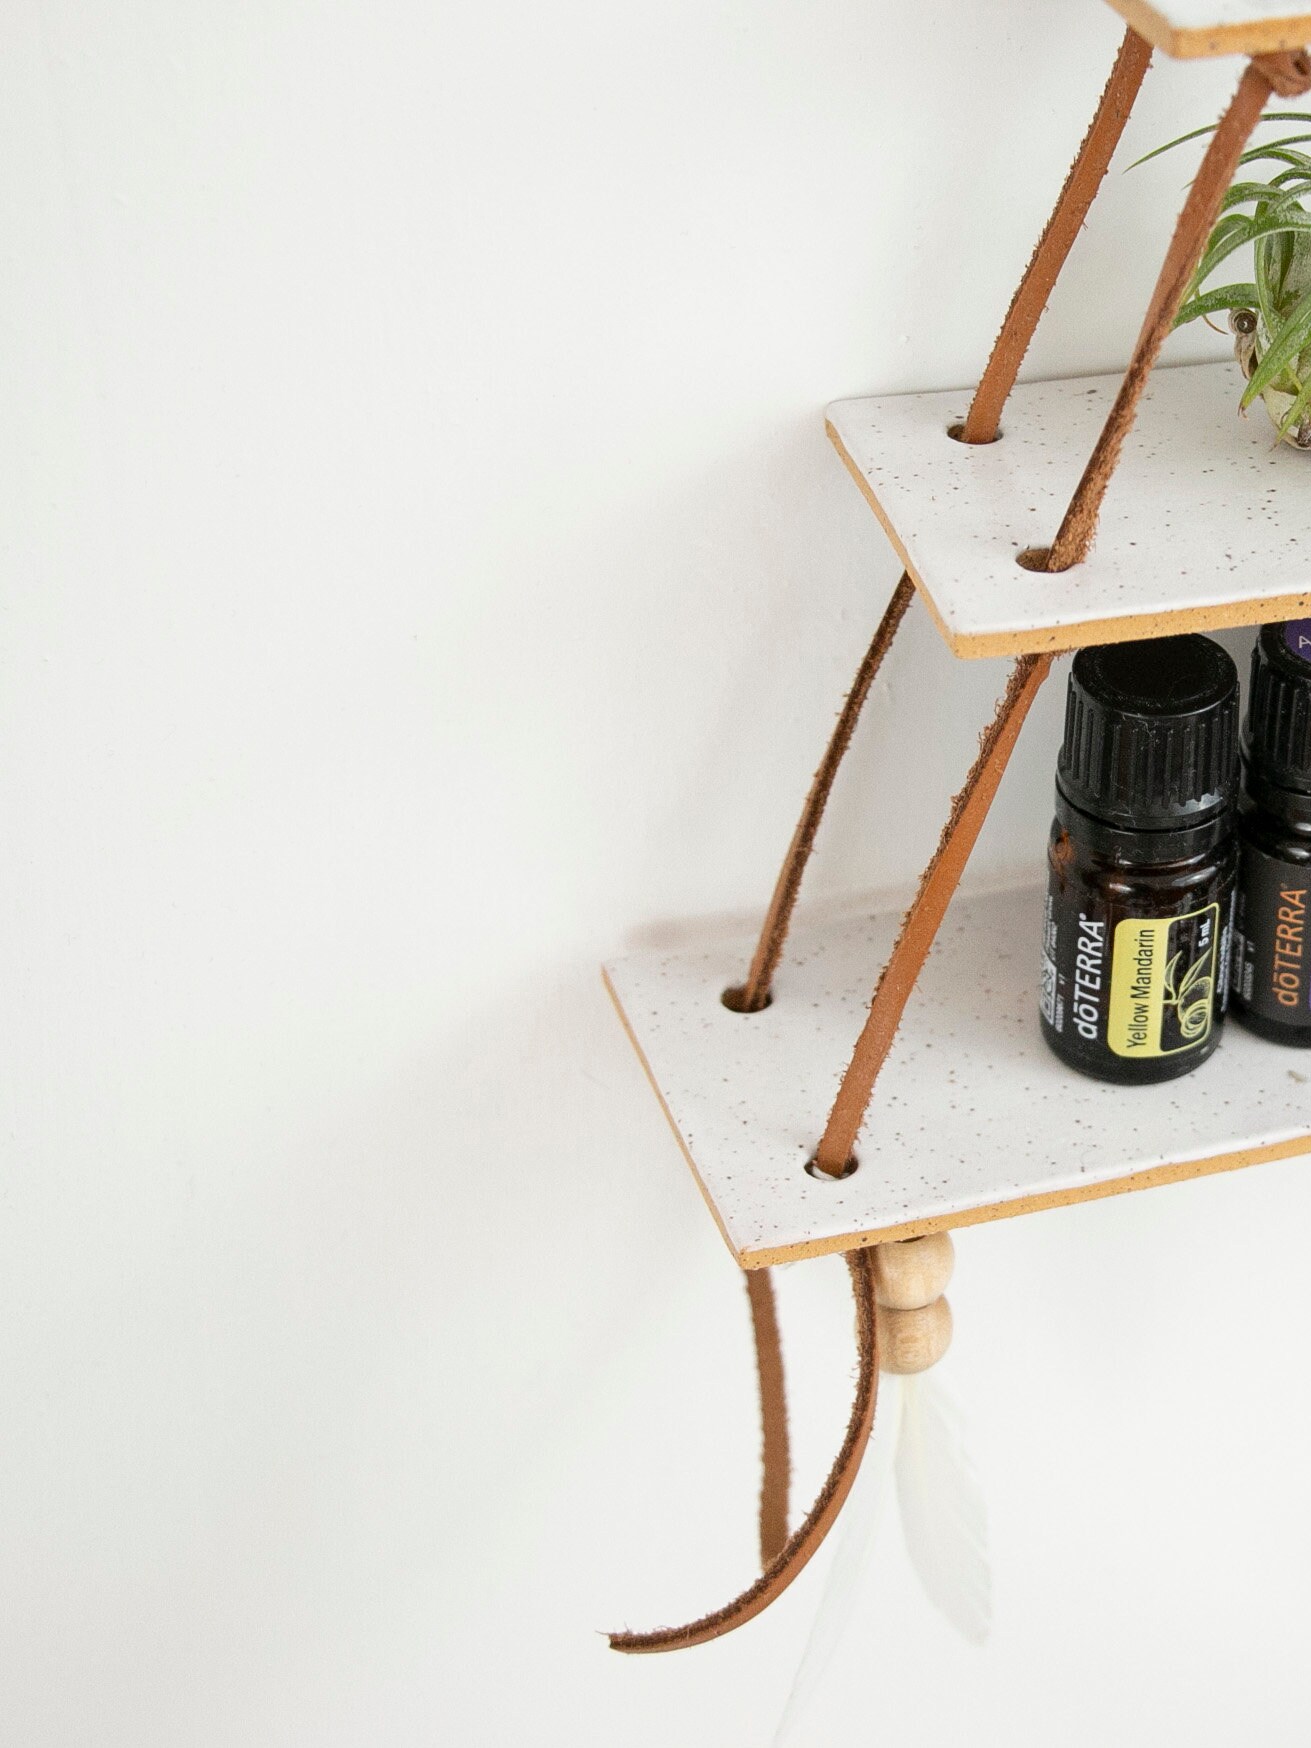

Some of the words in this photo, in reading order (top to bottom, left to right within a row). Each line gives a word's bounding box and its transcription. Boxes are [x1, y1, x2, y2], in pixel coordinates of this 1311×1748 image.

[1132, 928, 1155, 999] Mandarin
[1198, 936, 1208, 948] 5
[1126, 1003, 1149, 1048] Yellow
